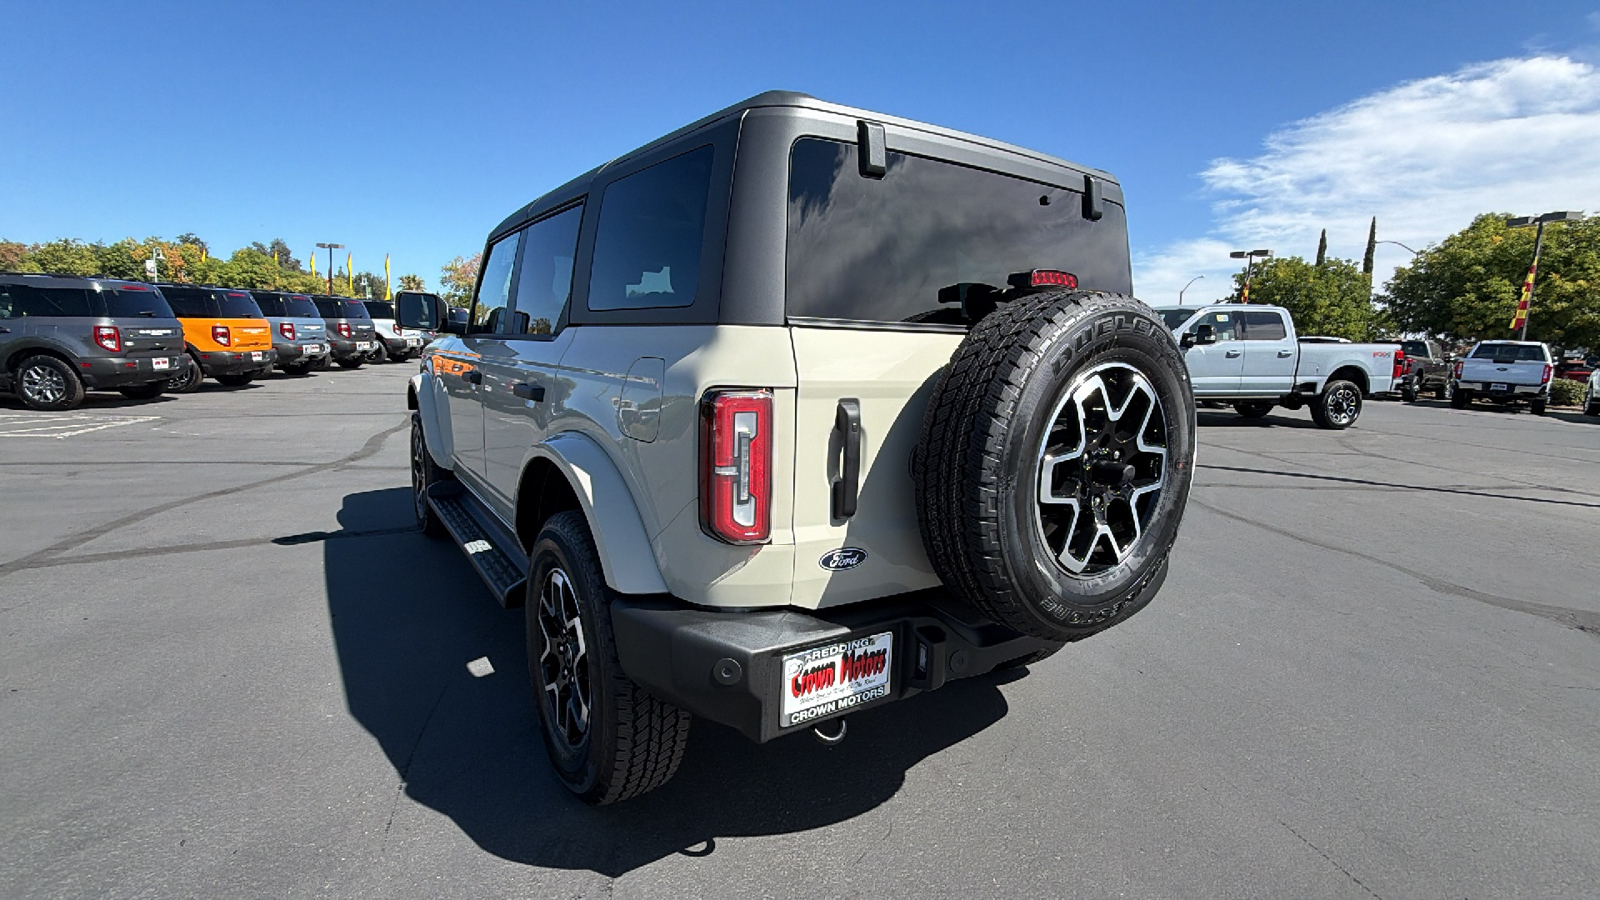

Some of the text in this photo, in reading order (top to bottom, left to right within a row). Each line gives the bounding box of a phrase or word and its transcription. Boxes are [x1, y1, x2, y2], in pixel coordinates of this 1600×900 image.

[1051, 314, 1169, 379] DUELER
[829, 551, 859, 568] Ford
[812, 639, 870, 660] REDDING
[791, 661, 836, 698] Crown
[840, 648, 887, 684] Motors
[791, 701, 836, 723] CROWN
[838, 686, 885, 709] MOTORS
